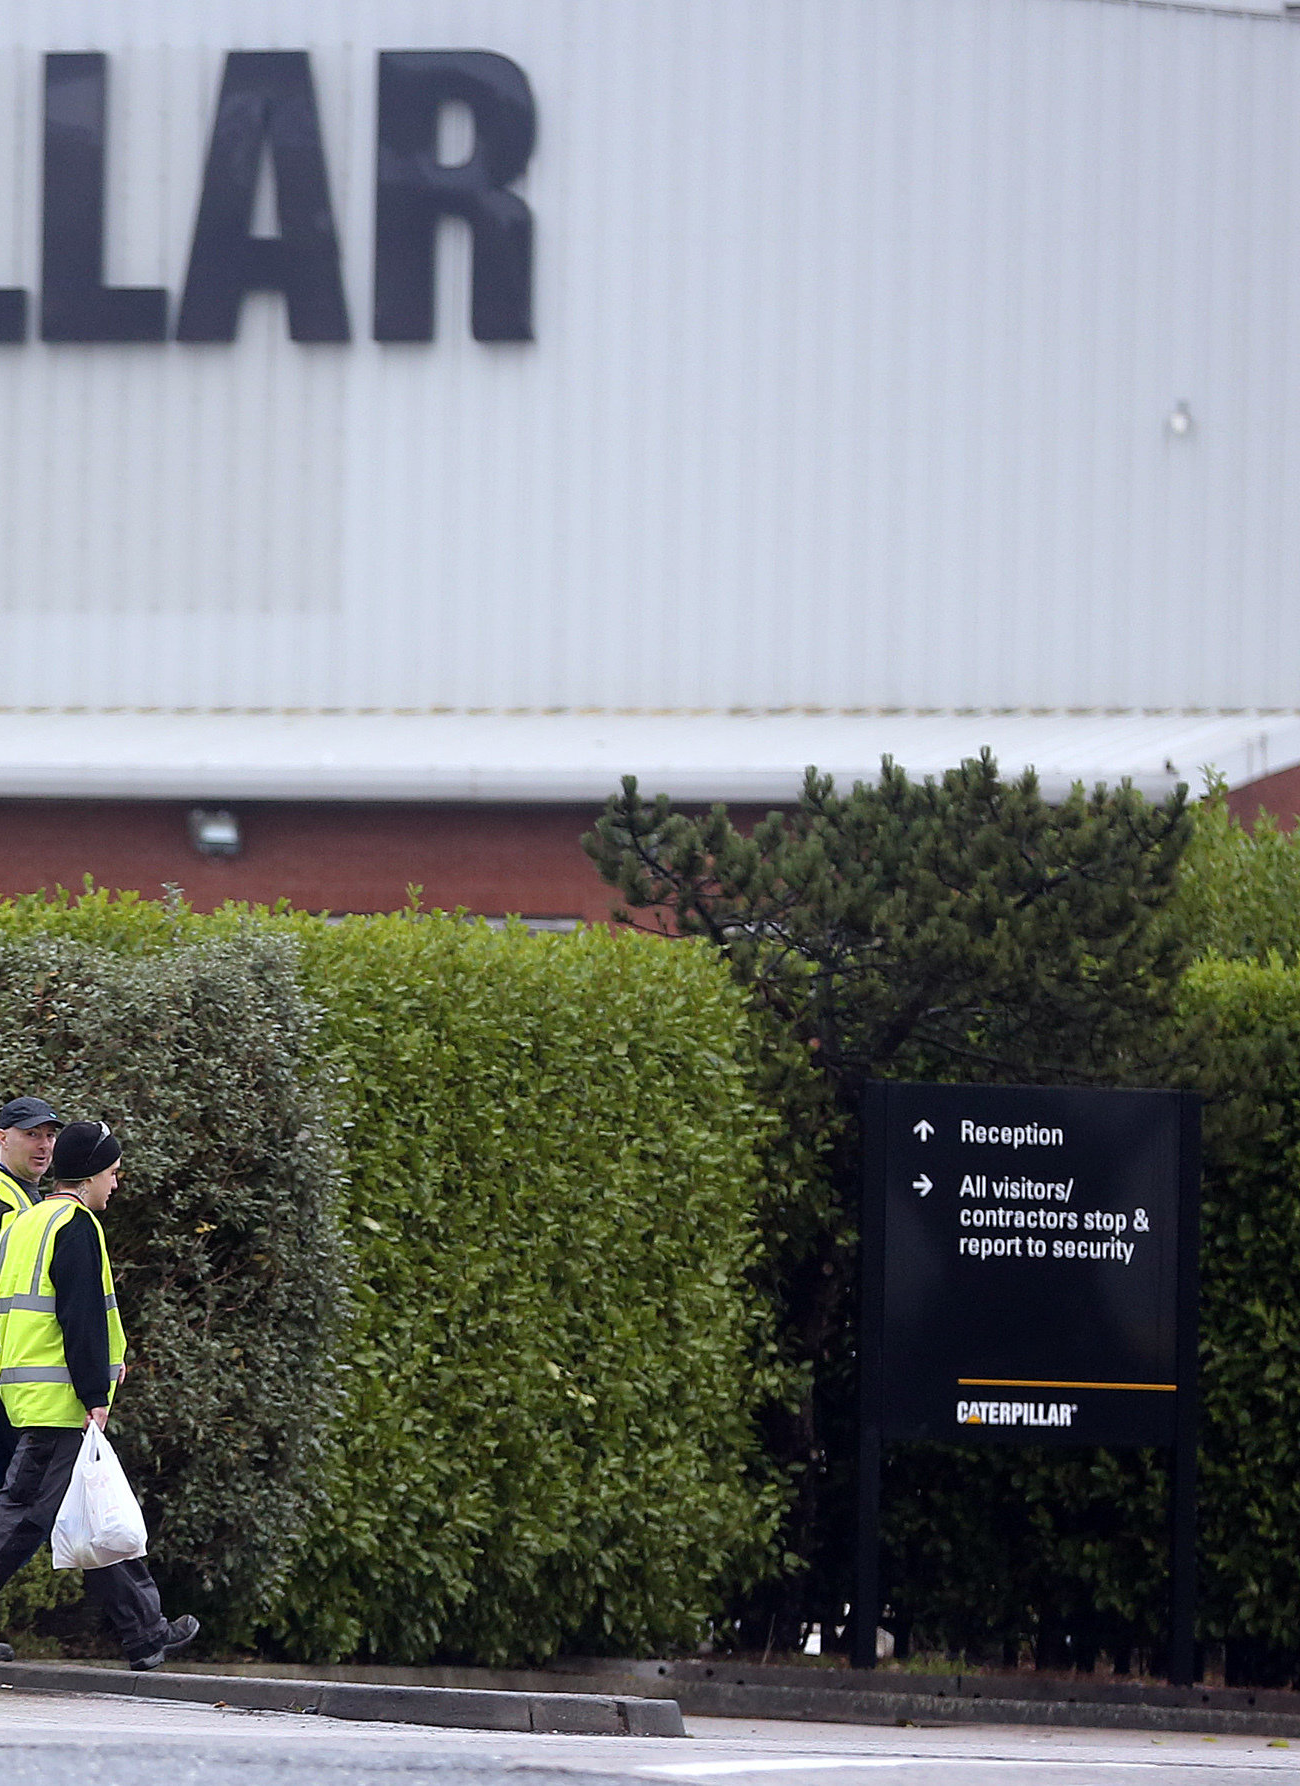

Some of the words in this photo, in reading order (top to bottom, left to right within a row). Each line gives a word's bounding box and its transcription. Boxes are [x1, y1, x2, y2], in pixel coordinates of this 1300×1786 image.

[960, 1119, 1064, 1149] Reception
[959, 1174, 987, 1199] All
[991, 1176, 1074, 1203] visitors/
[959, 1206, 1078, 1230] contractors
[1083, 1209, 1127, 1236] stop
[1132, 1207, 1150, 1232] &
[959, 1236, 1023, 1260] report
[1025, 1236, 1047, 1258] to
[1052, 1236, 1135, 1265] security
